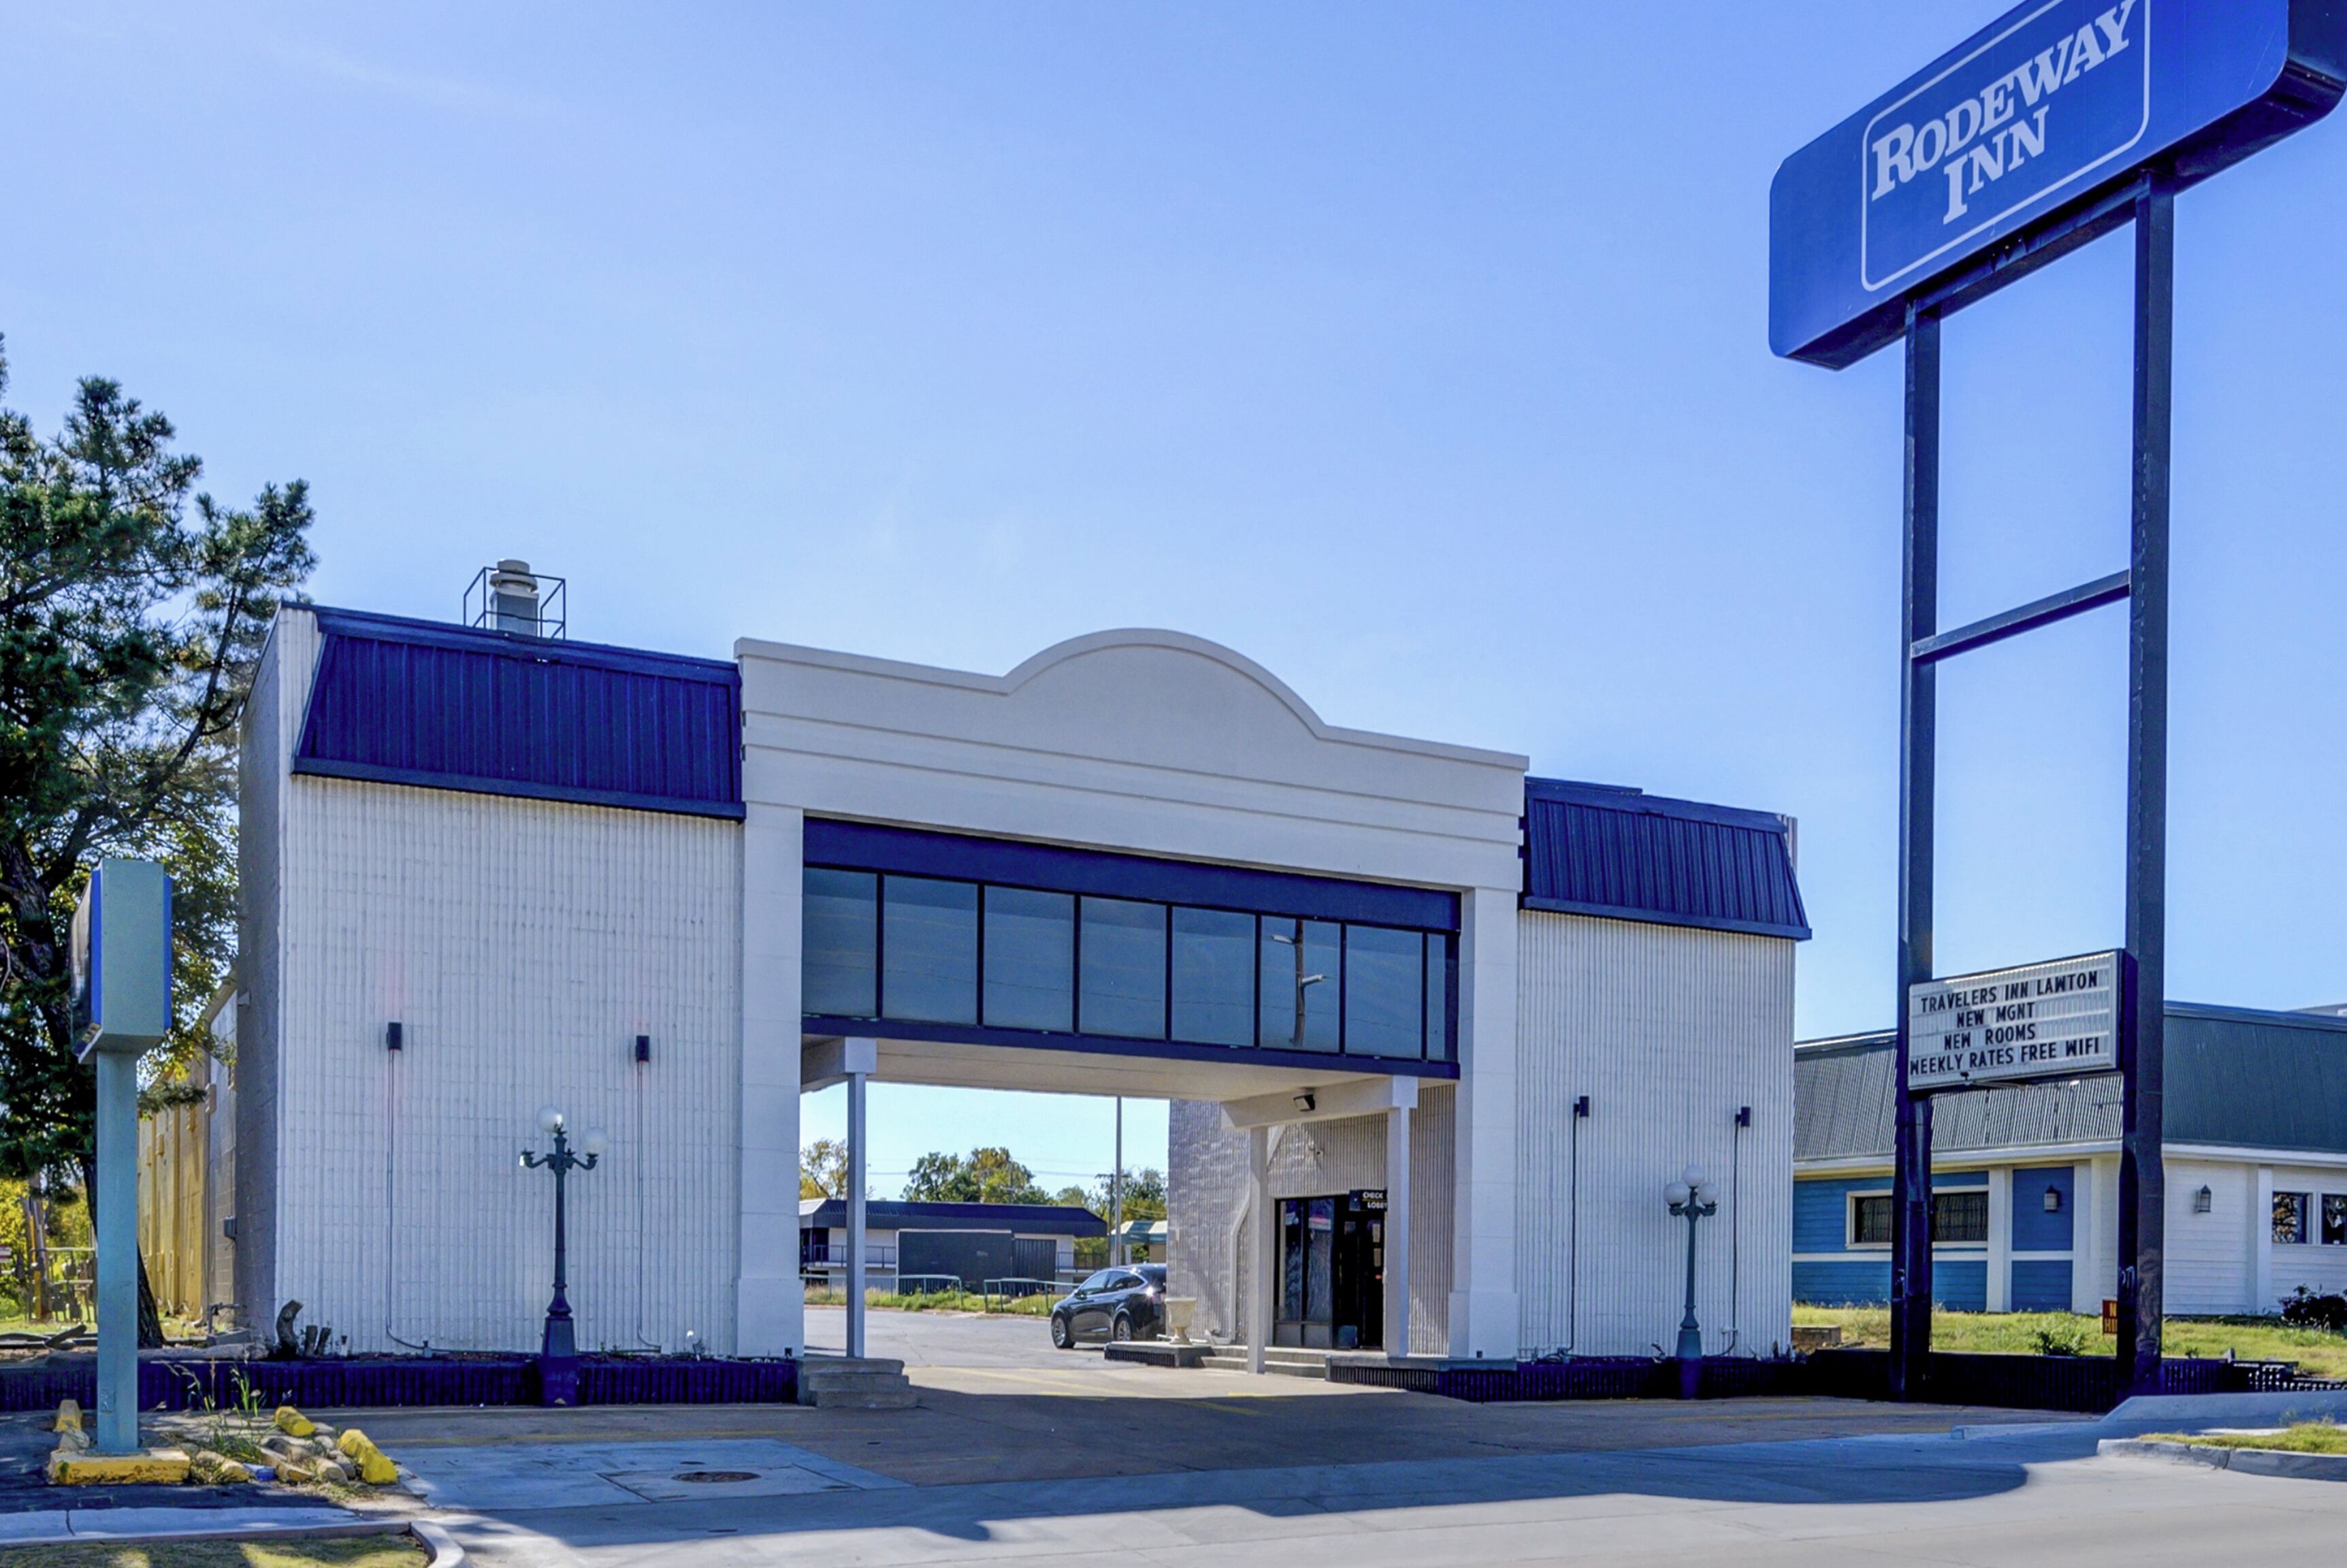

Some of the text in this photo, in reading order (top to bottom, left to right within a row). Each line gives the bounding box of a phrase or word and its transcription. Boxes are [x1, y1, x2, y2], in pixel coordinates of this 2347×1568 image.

[1872, 0, 2134, 202] RODEWAY
[1943, 103, 2050, 226] INN
[1921, 970, 2099, 1013] TRAVELERS INN LAWTON
[1957, 1002, 2035, 1028] NEW MGNT
[1910, 1037, 2099, 1076] WEEKLY RATES FREE WIFI
[1945, 1024, 2036, 1051] NEW ROOMS
